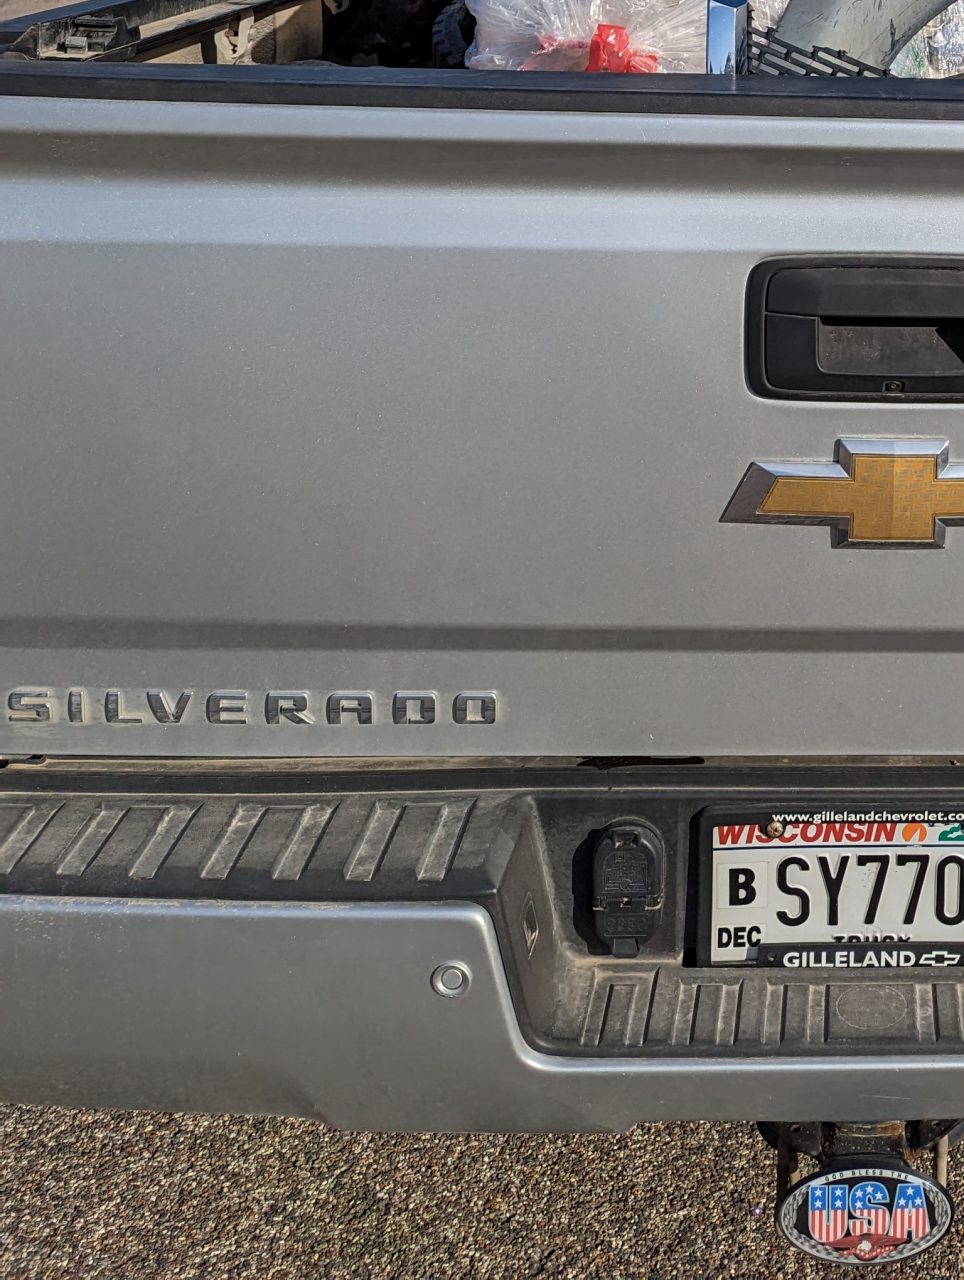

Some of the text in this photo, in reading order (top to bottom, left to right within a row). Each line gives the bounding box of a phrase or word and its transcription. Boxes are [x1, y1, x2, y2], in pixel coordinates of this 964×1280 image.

[8, 690, 500, 725] SILVERADO
[728, 867, 757, 907] B
[717, 926, 762, 948] DEC
[782, 950, 917, 968] GILLELAND
[825, 1169, 908, 1182] GOD BLESS THE
[807, 1181, 931, 1242] USA
